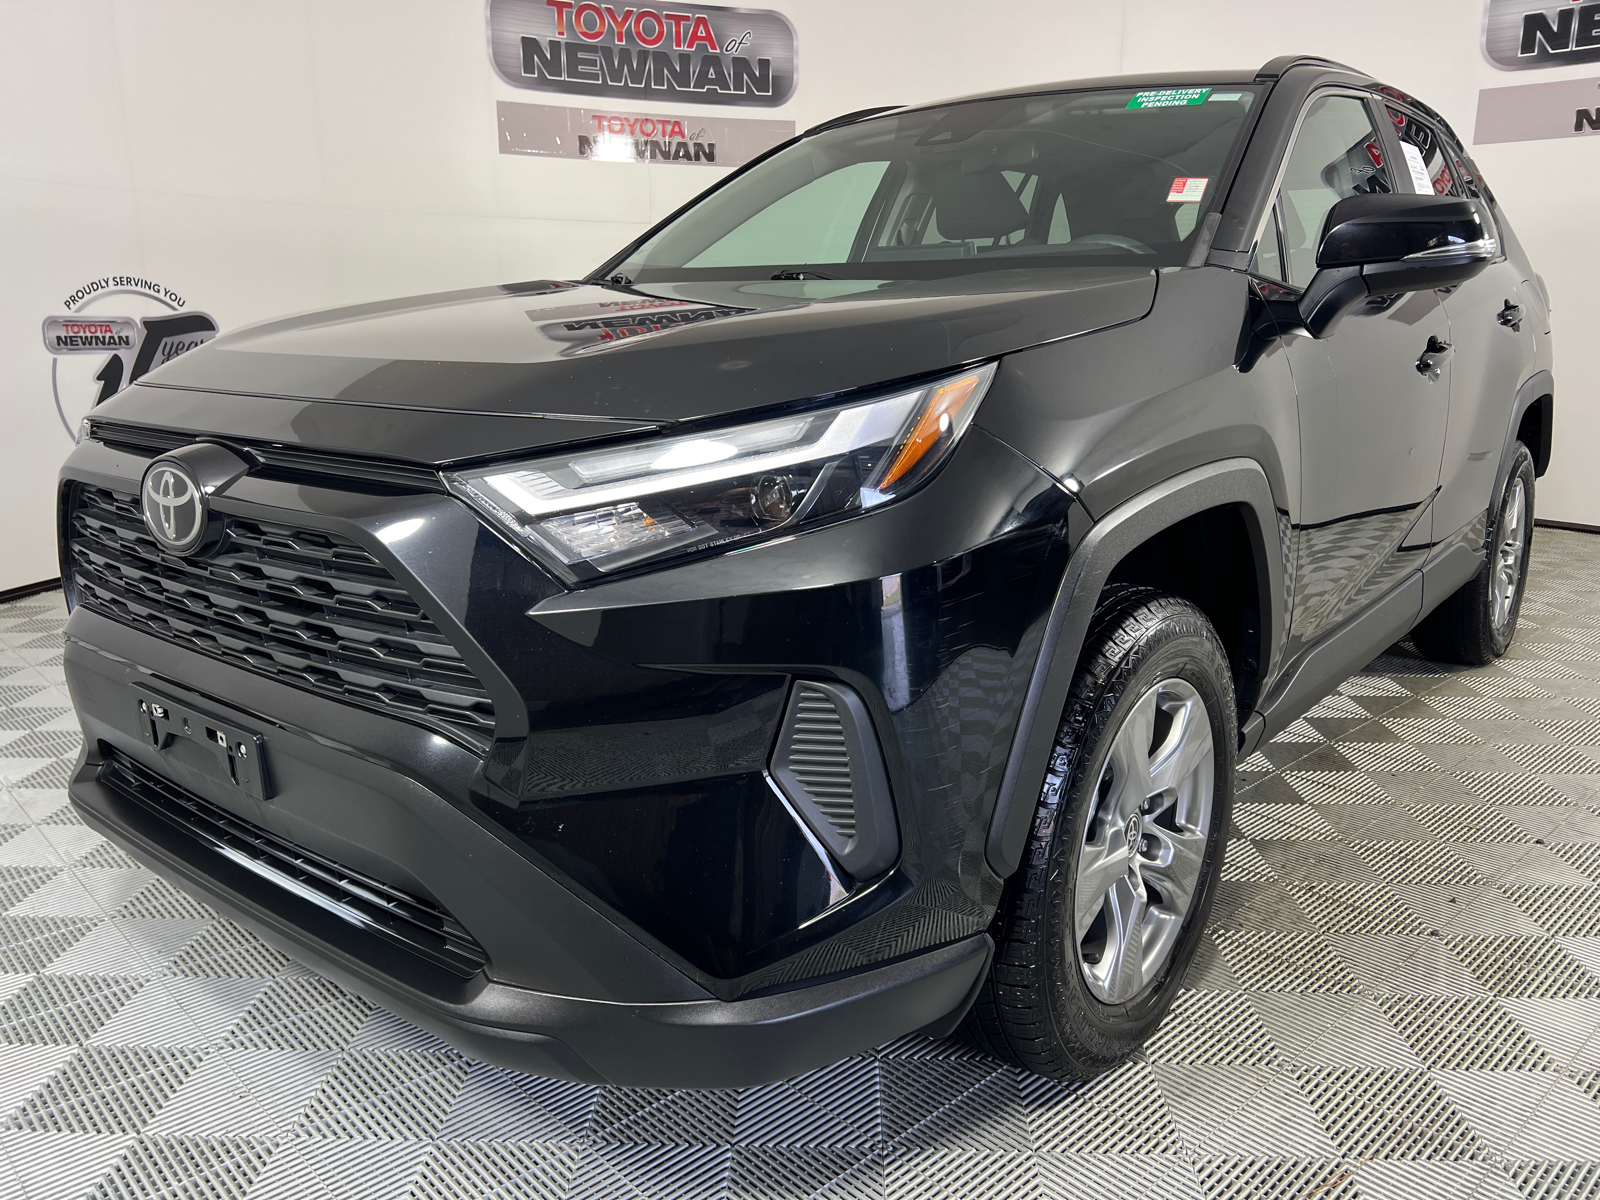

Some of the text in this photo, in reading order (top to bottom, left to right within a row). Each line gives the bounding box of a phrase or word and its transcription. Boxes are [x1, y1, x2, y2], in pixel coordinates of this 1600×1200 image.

[546, 0, 752, 54] TOYOTA of
[520, 35, 773, 96] NEWNAN
[1136, 88, 1209, 98] PRE-DELIVERY
[1137, 94, 1200, 103] INSPECTION
[1140, 100, 1188, 108] PENDING
[591, 114, 706, 142] TOYOTA of
[63, 276, 187, 310] PROUDLY SERVING YOU
[62, 323, 114, 335] TOYOTA
[55, 335, 131, 347] NEWNAN
